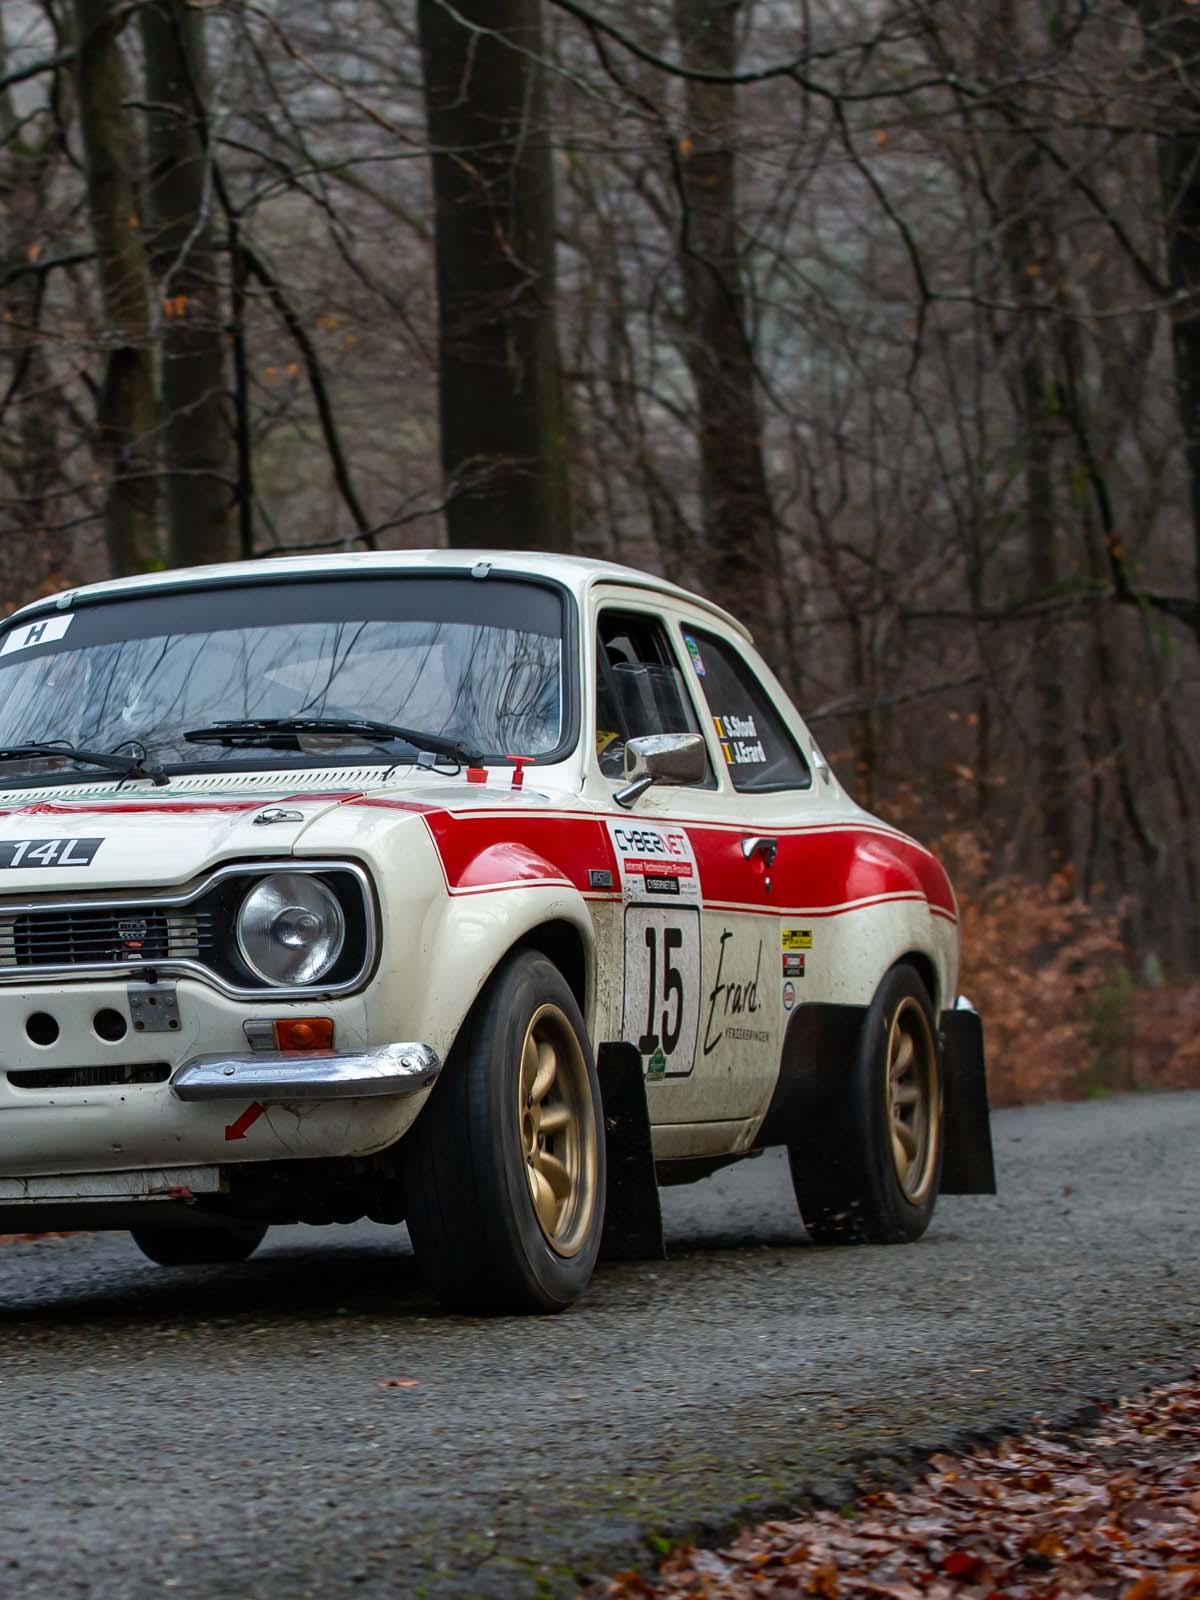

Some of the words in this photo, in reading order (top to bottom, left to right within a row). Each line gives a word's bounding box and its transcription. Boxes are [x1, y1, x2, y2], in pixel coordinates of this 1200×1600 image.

[24, 622, 48, 645] H
[9, 839, 89, 866] 14L
[614, 829, 687, 855] CYBERNET
[638, 926, 683, 1055] 15
